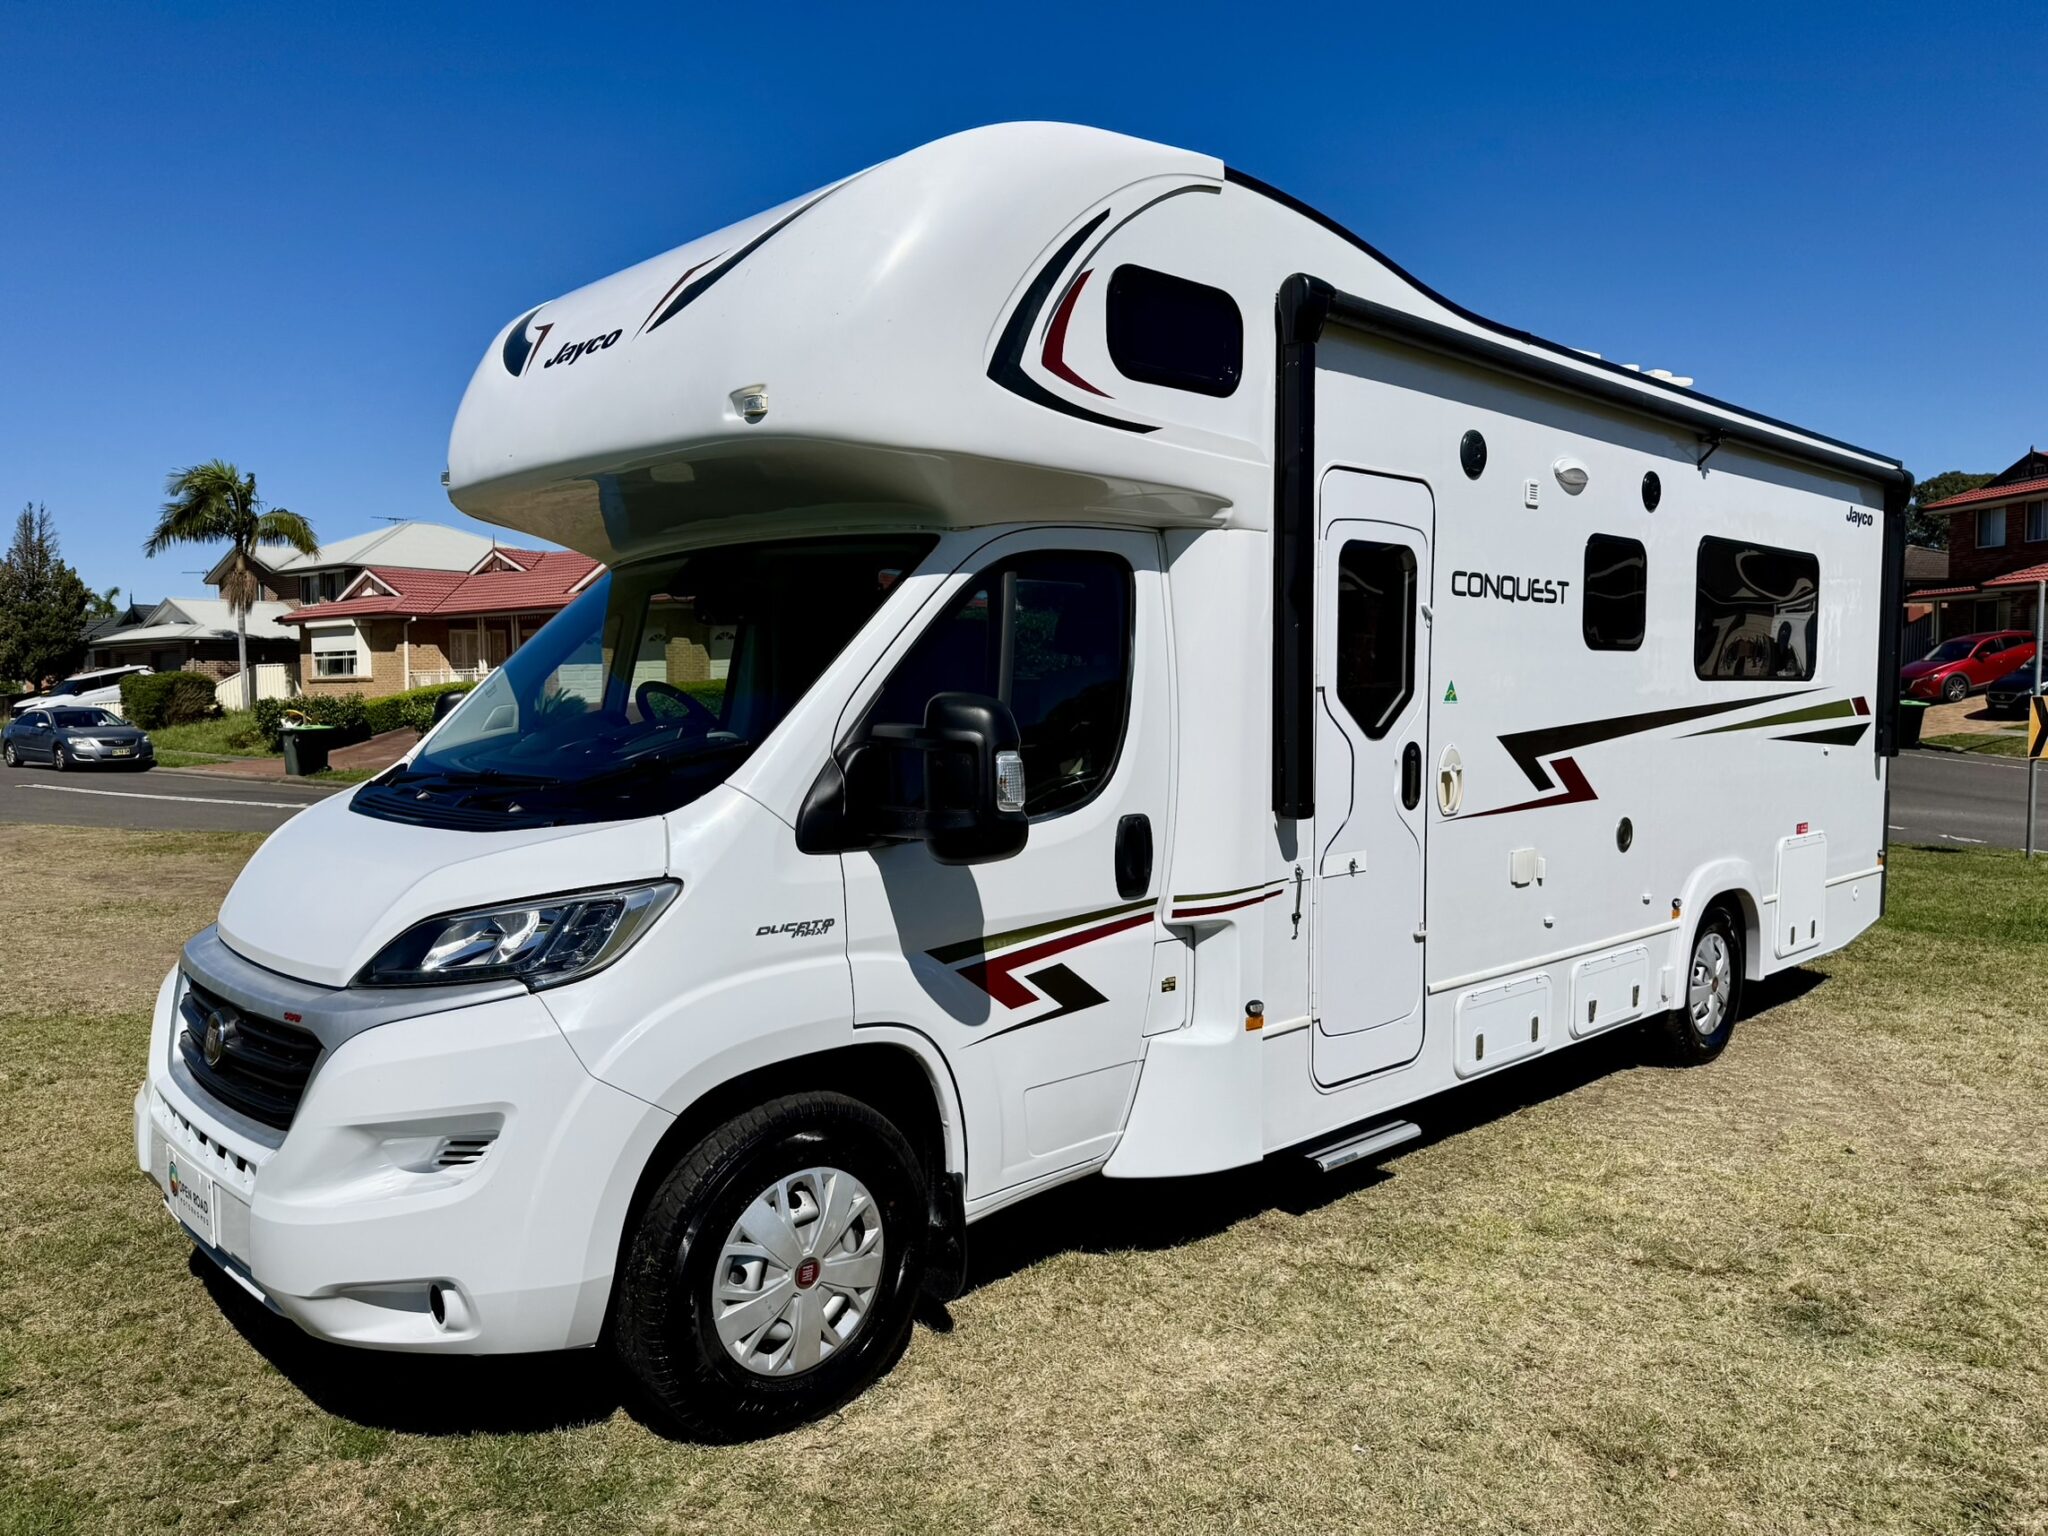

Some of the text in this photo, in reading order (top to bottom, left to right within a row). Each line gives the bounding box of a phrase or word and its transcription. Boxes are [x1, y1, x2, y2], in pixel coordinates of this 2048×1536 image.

[543, 329, 623, 369] Jayco
[1846, 505, 1873, 528] Jayco
[1451, 570, 1570, 605] CONQUEST
[755, 918, 835, 936] DUCATO
[193, 1192, 208, 1214] ROAD
[802, 1264, 814, 1282] FIAT
